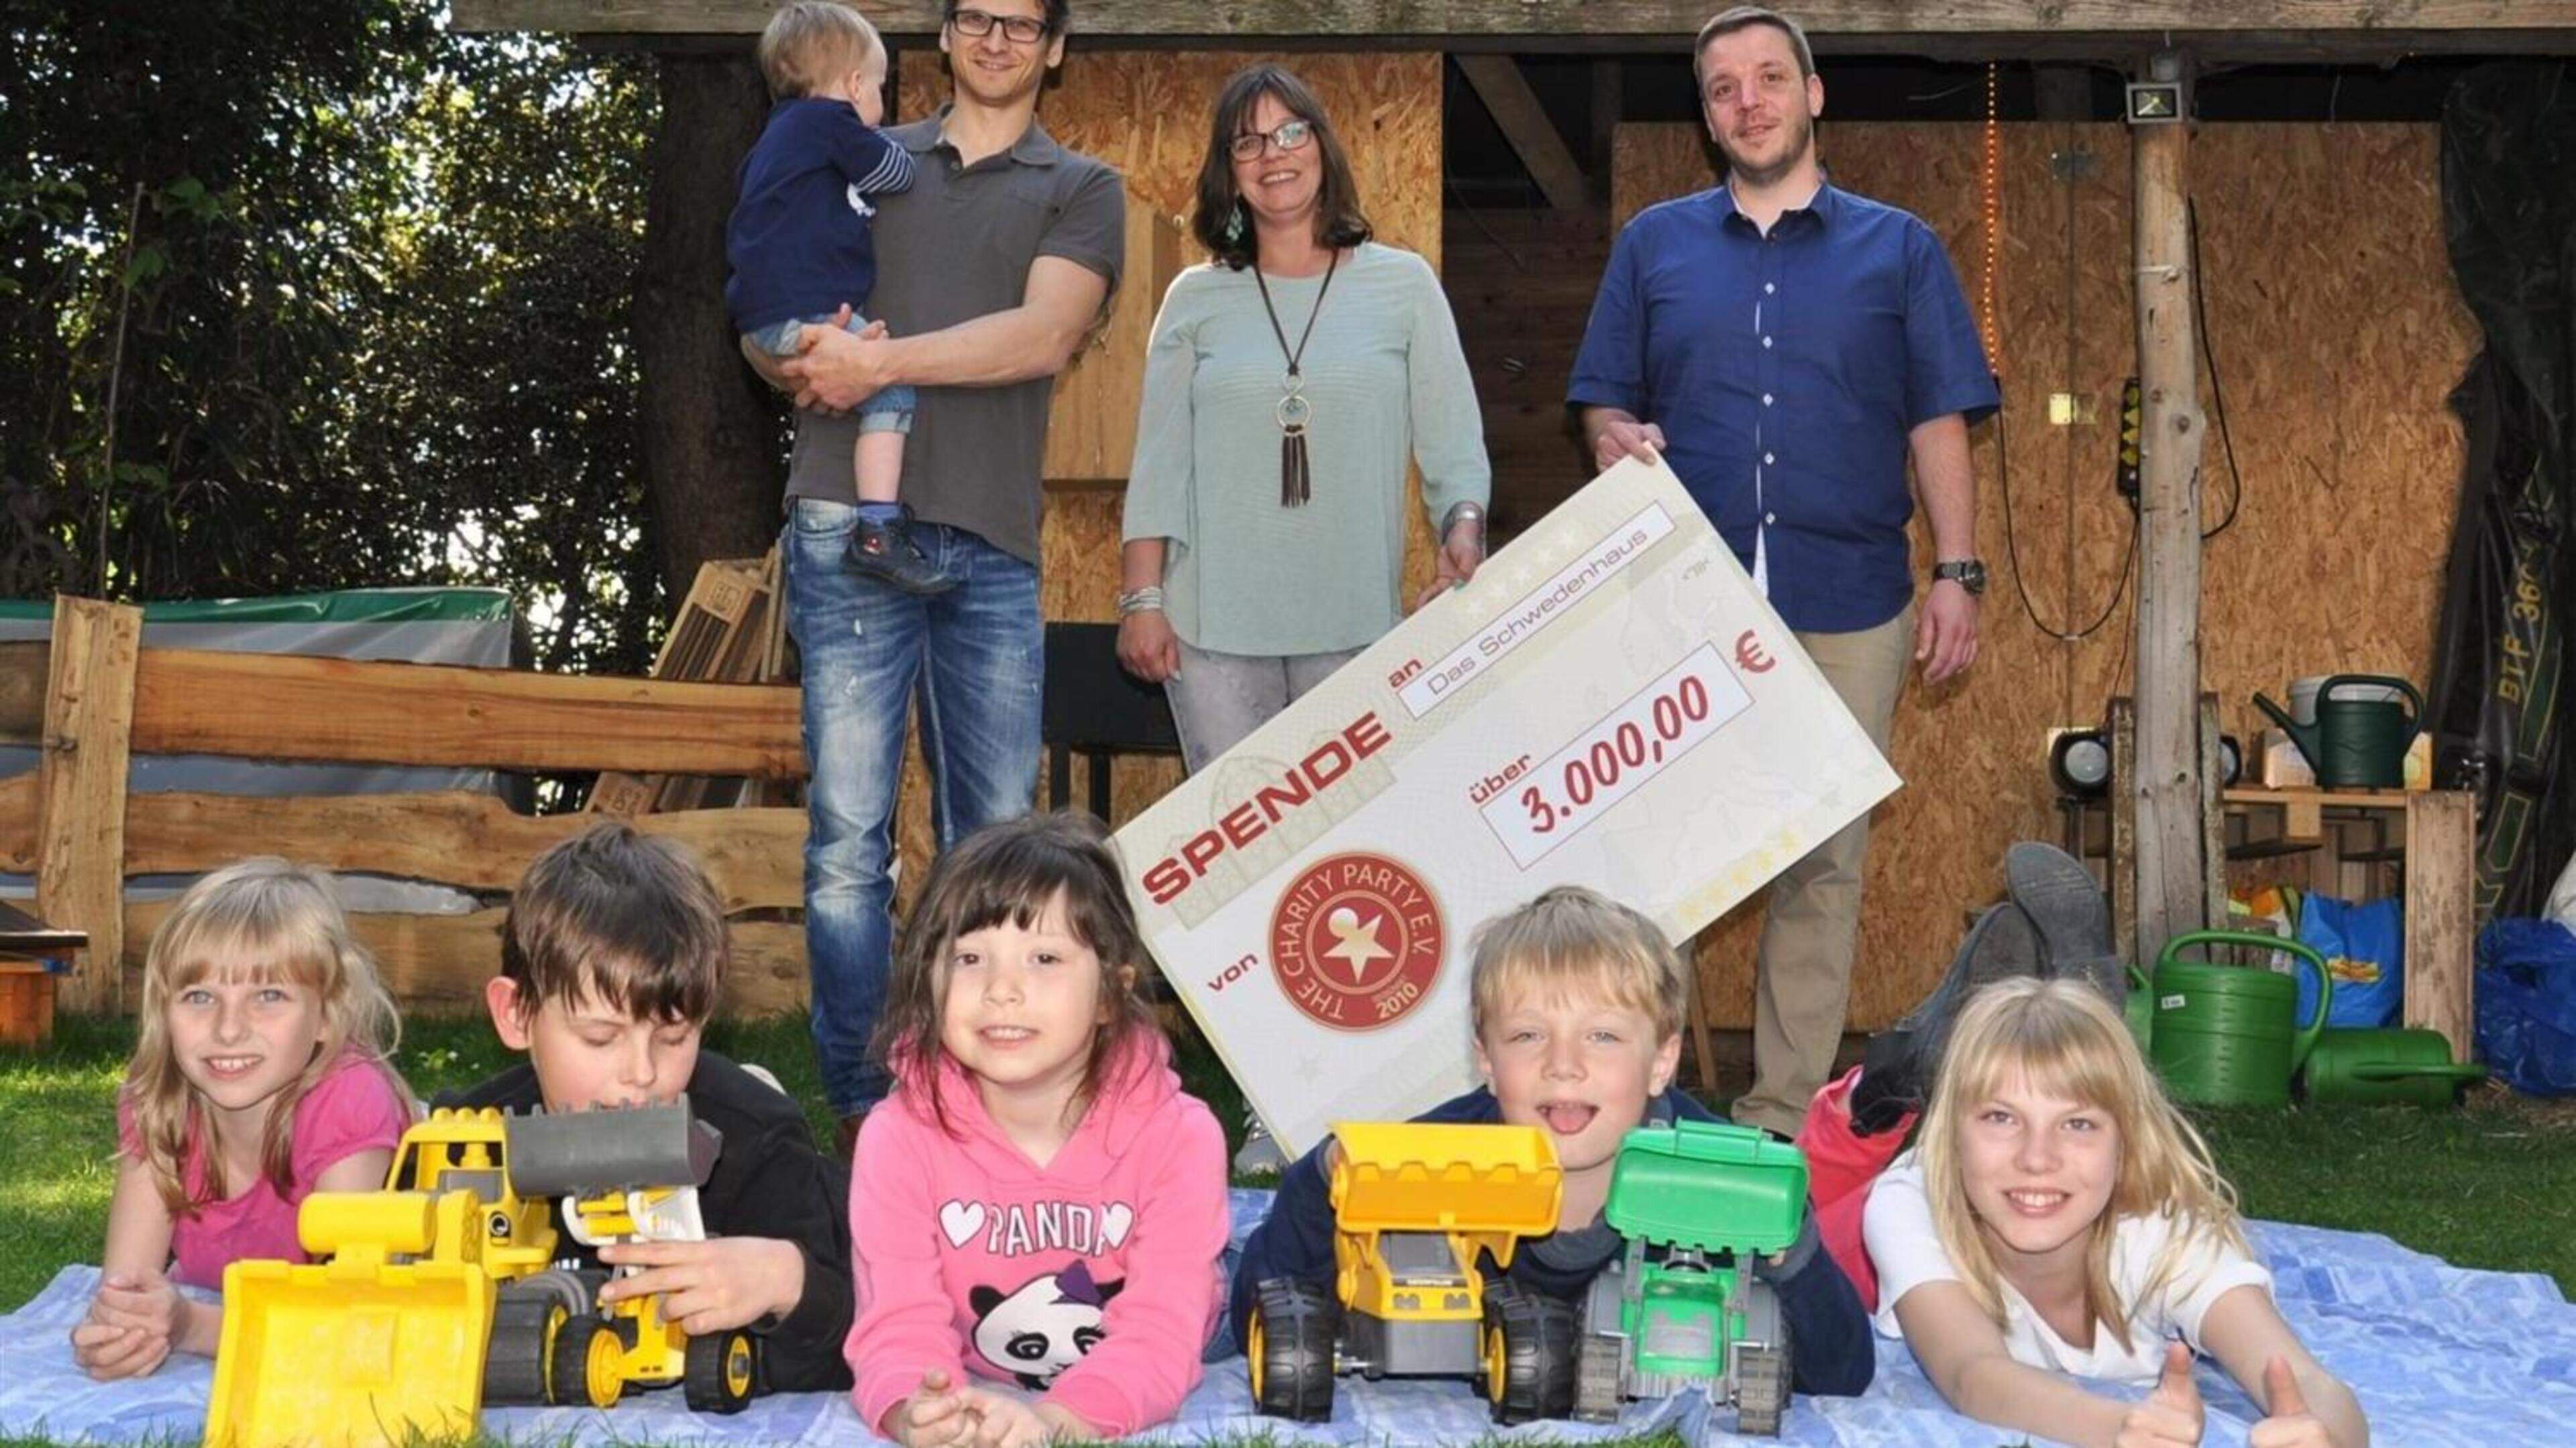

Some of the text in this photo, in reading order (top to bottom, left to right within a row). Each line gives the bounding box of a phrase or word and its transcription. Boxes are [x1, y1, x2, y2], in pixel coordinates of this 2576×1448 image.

[1388, 529, 1648, 695] an Das Schwedenhaus
[1521, 629, 1776, 834] 3.000,00 €
[1469, 752, 1532, 804] über
[1142, 711, 1393, 905] SPENDE
[1343, 863, 1424, 910] PARTY
[1279, 868, 1334, 977] CHARITY
[1409, 913, 1436, 956] E.V.
[1208, 953, 1258, 991] von
[1297, 977, 1344, 1020] THE
[1375, 982, 1419, 1020] 2010
